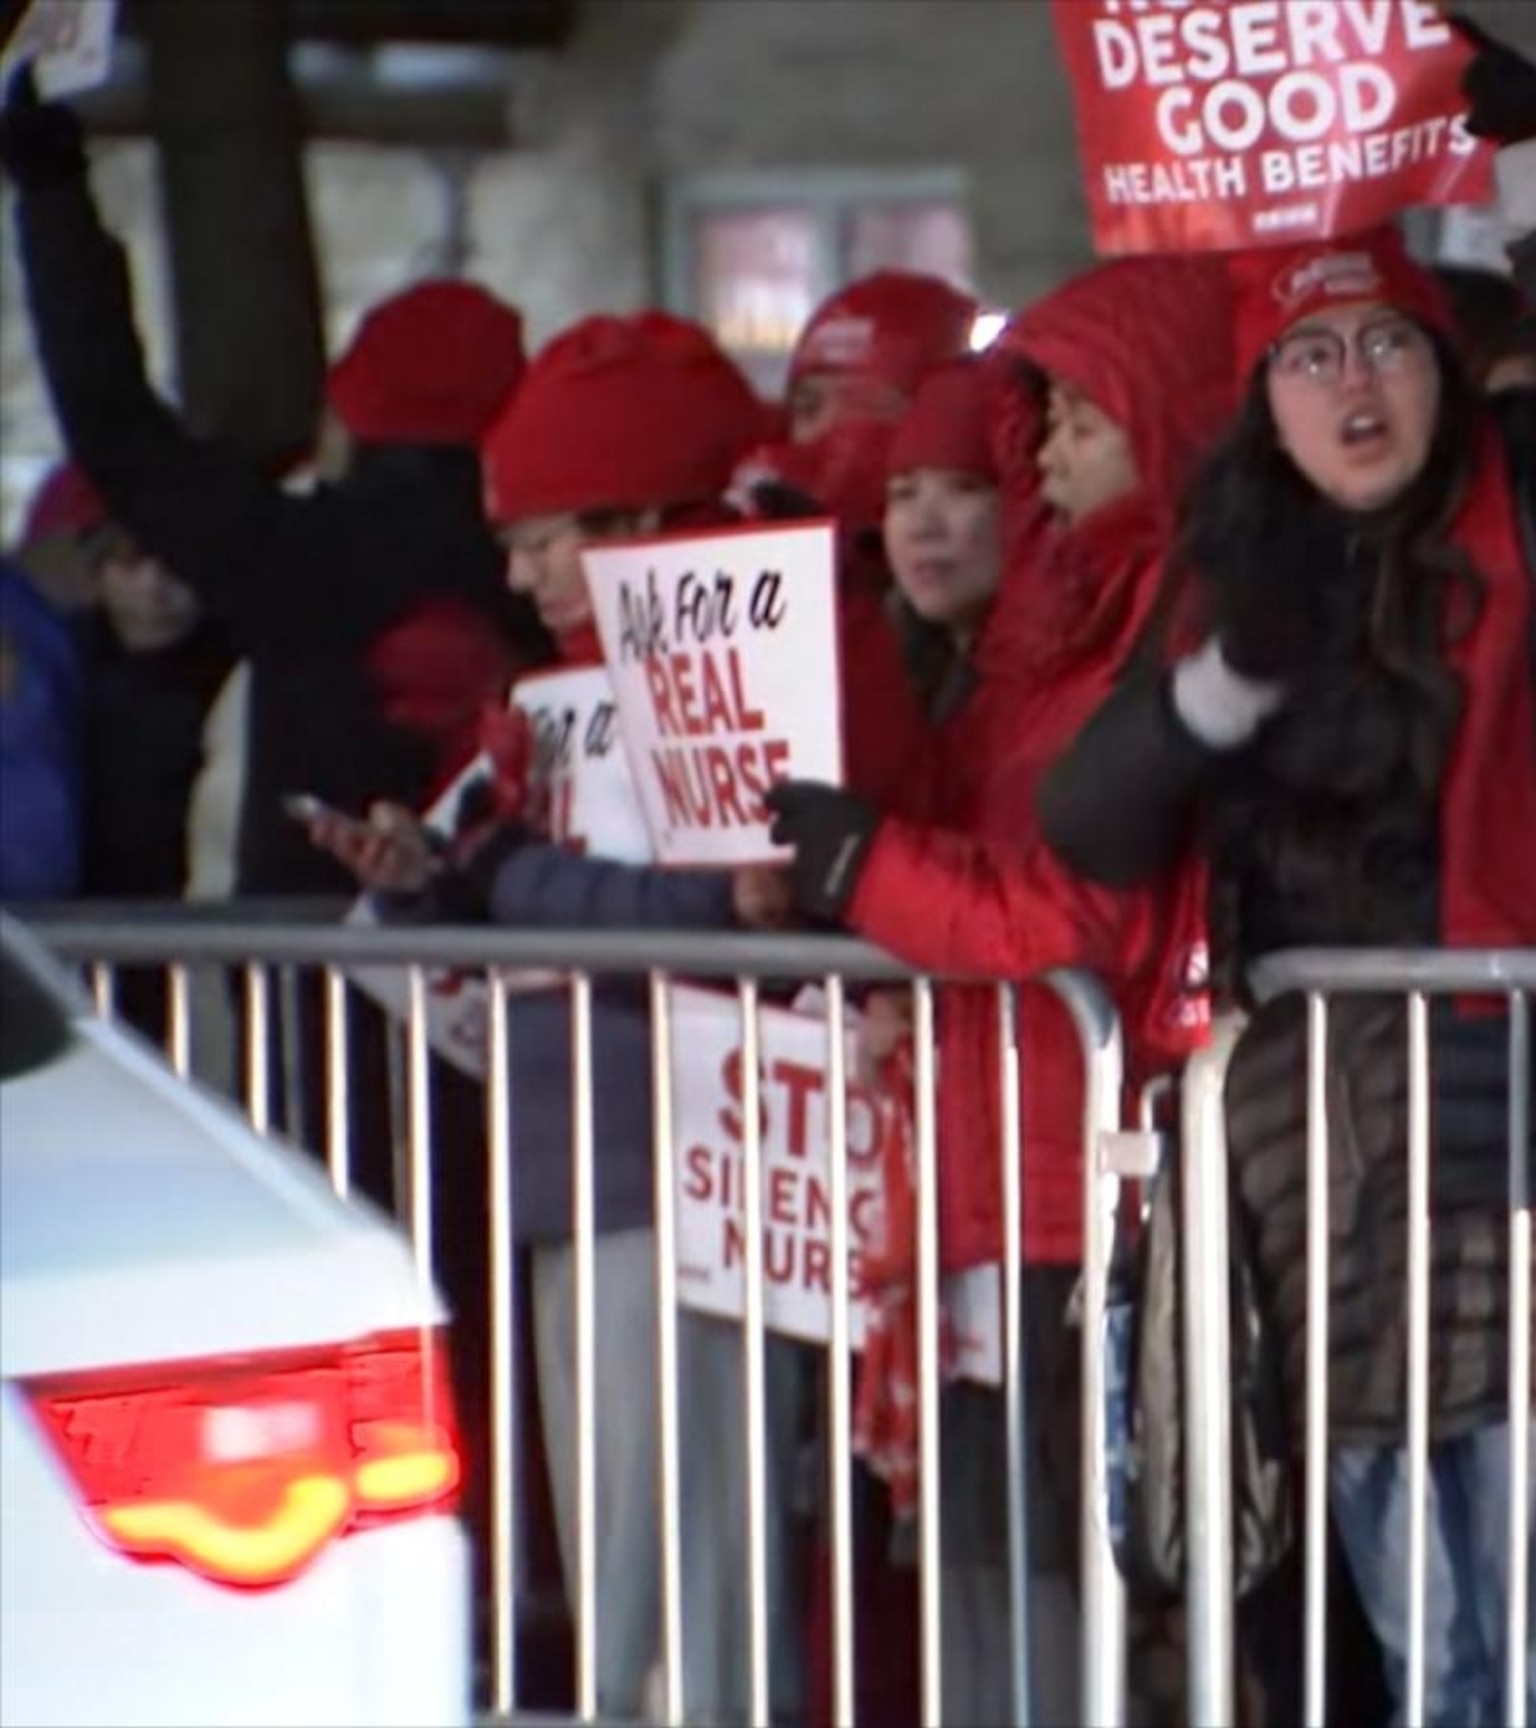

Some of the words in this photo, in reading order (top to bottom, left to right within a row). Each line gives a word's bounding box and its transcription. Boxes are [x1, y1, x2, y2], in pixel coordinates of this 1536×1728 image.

[1092, 0, 1451, 89] DESERVE
[1155, 62, 1398, 155] GOOD
[1104, 154, 1246, 204] HEALTH
[1261, 113, 1478, 194] BENEFITS
[749, 569, 787, 631] a
[644, 646, 765, 738] REAL
